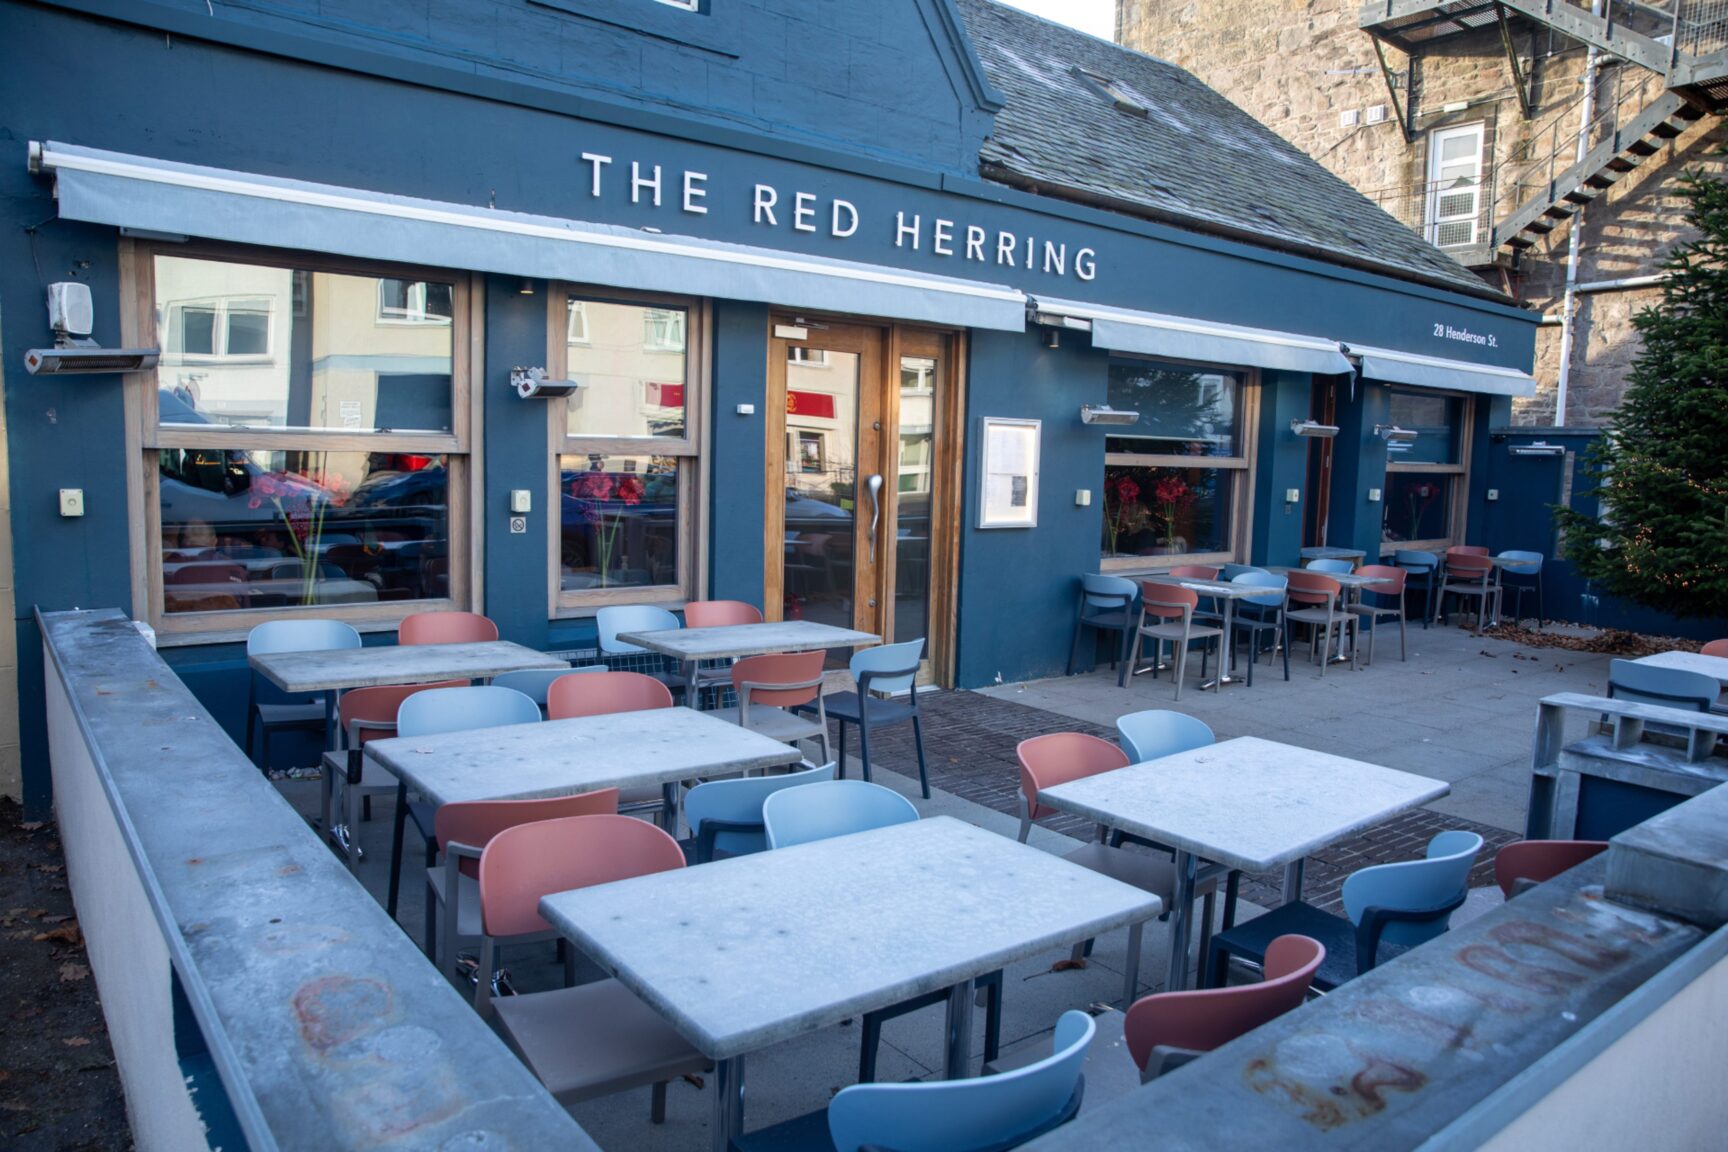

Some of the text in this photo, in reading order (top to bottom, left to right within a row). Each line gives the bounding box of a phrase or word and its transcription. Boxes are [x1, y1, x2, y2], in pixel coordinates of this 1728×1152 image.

[582, 152, 1096, 280] THE RED HERRING
[1433, 323, 1498, 347] 28 Henderson St.
